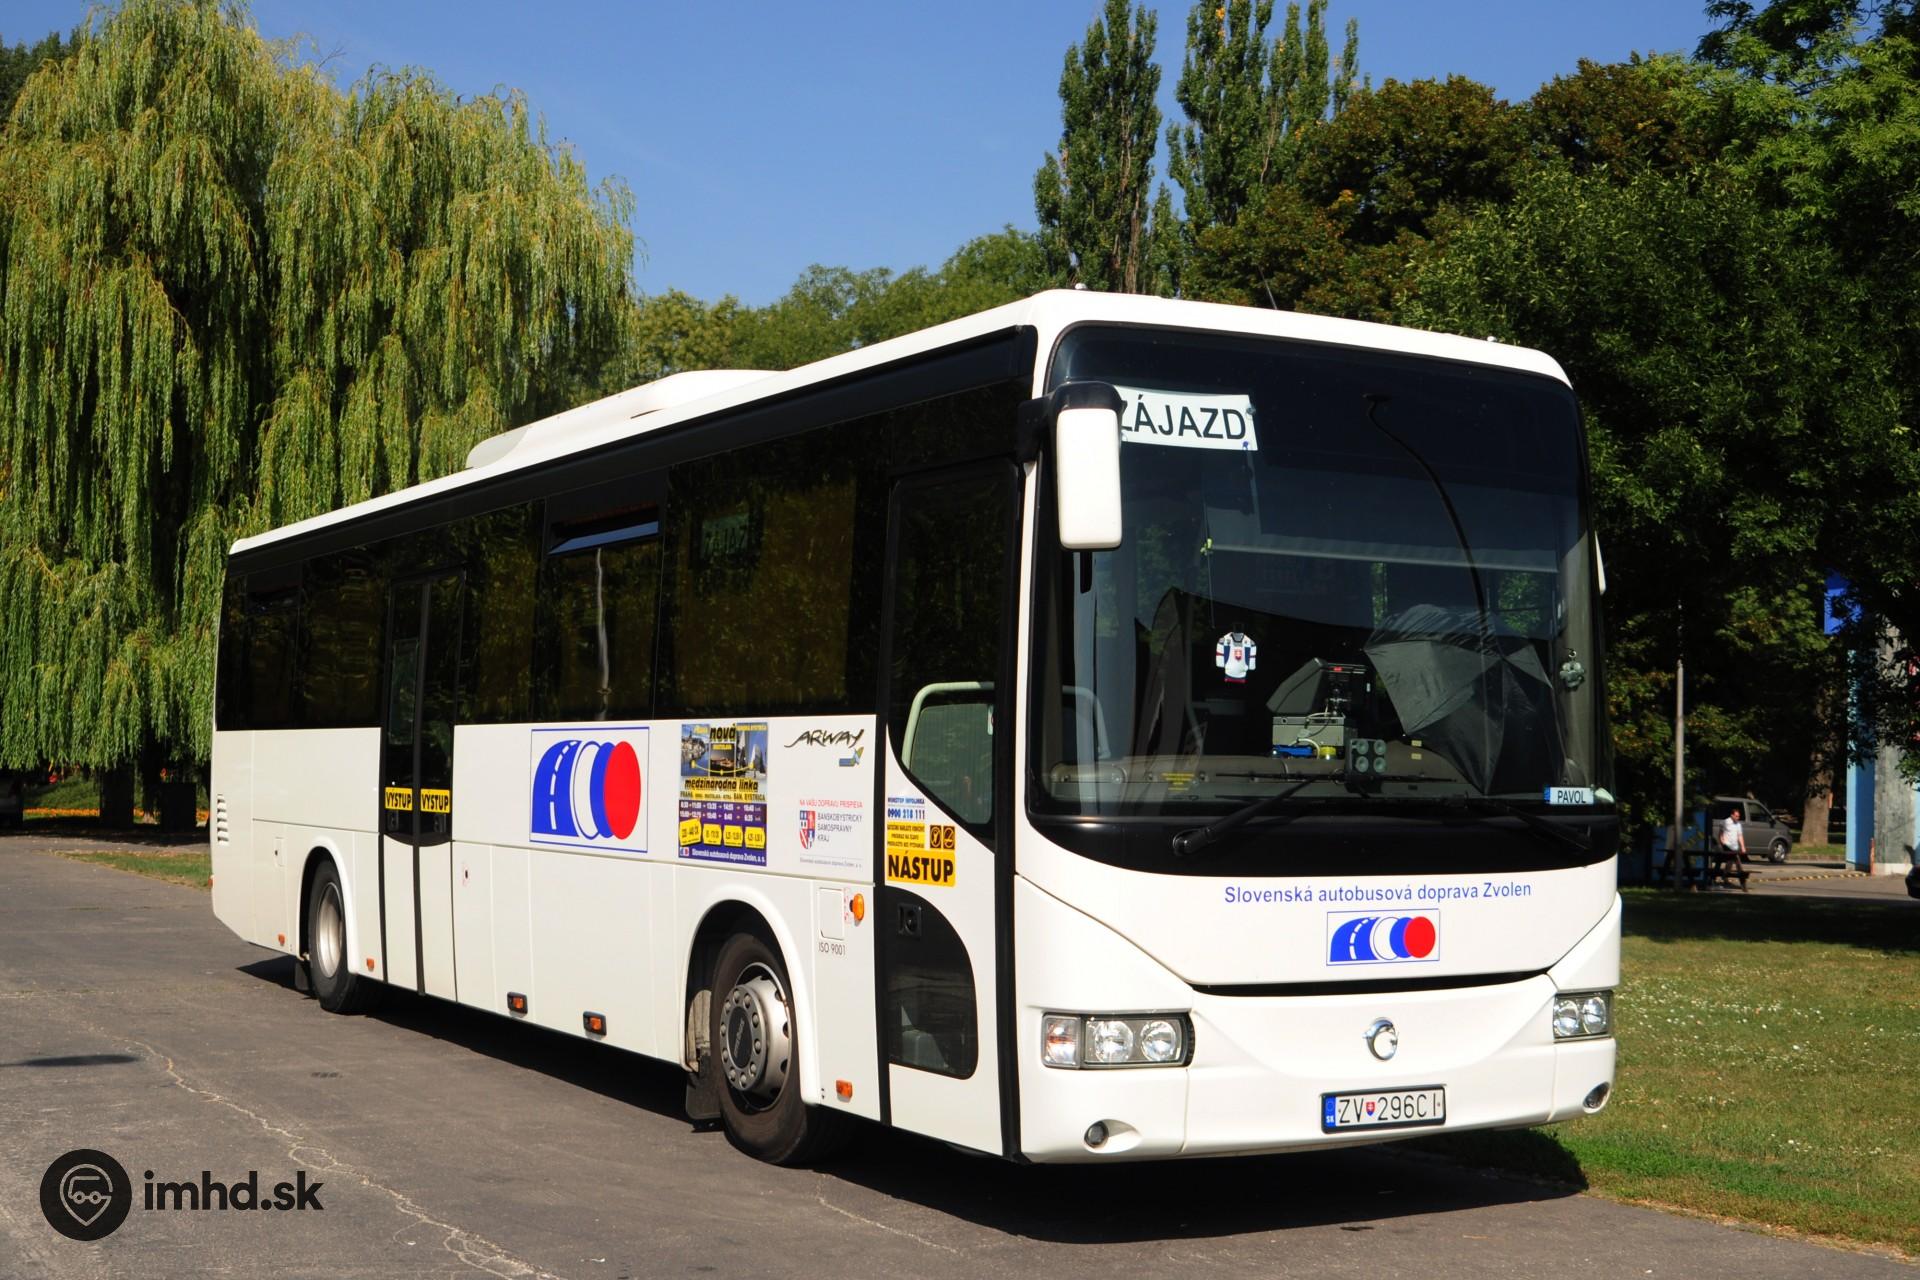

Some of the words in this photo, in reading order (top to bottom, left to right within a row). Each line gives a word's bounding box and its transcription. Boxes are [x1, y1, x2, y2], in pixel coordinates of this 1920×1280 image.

[709, 723, 736, 740] nová
[784, 728, 865, 749] ARWAY
[739, 779, 759, 791] linka
[386, 789, 411, 809] VÝSTUP
[421, 790, 449, 811] VÝSTUP
[1557, 790, 1586, 804] PAVOL
[888, 807, 901, 819] 0900
[888, 850, 954, 883] NÁSTUP
[1225, 885, 1312, 903] Slovenská
[1318, 884, 1411, 902] autobusová
[1418, 884, 1478, 903] doprava
[1483, 882, 1531, 898] Zvolen
[818, 942, 829, 953] ISO
[831, 943, 845, 955] 9001
[1339, 1098, 1364, 1124] ZV
[1377, 1093, 1436, 1121] 296CI
